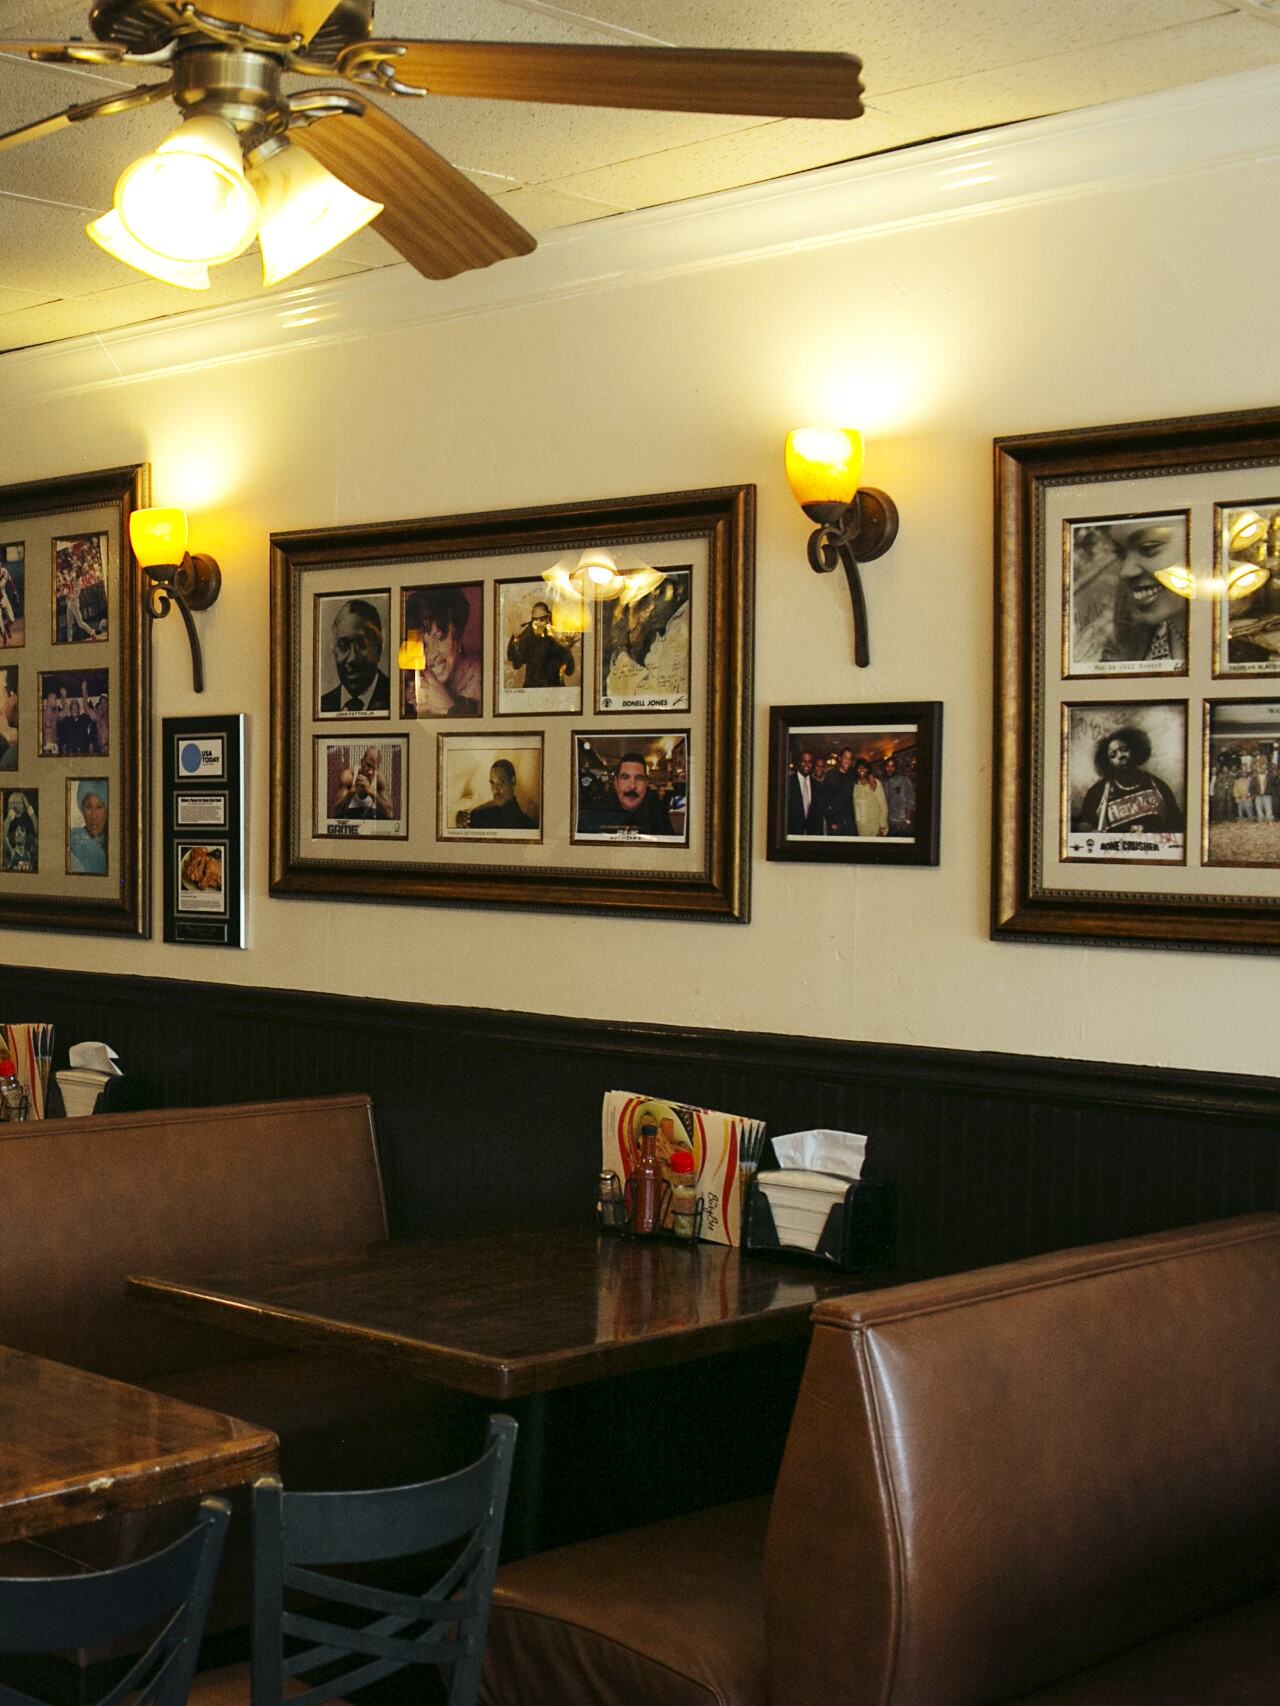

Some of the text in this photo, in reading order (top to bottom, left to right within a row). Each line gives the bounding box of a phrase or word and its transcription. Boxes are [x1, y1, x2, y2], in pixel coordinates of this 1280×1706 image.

[327, 825, 359, 835] GAME
[1122, 840, 1161, 852] CRUSHER
[703, 1191, 719, 1231] Busy Bee
